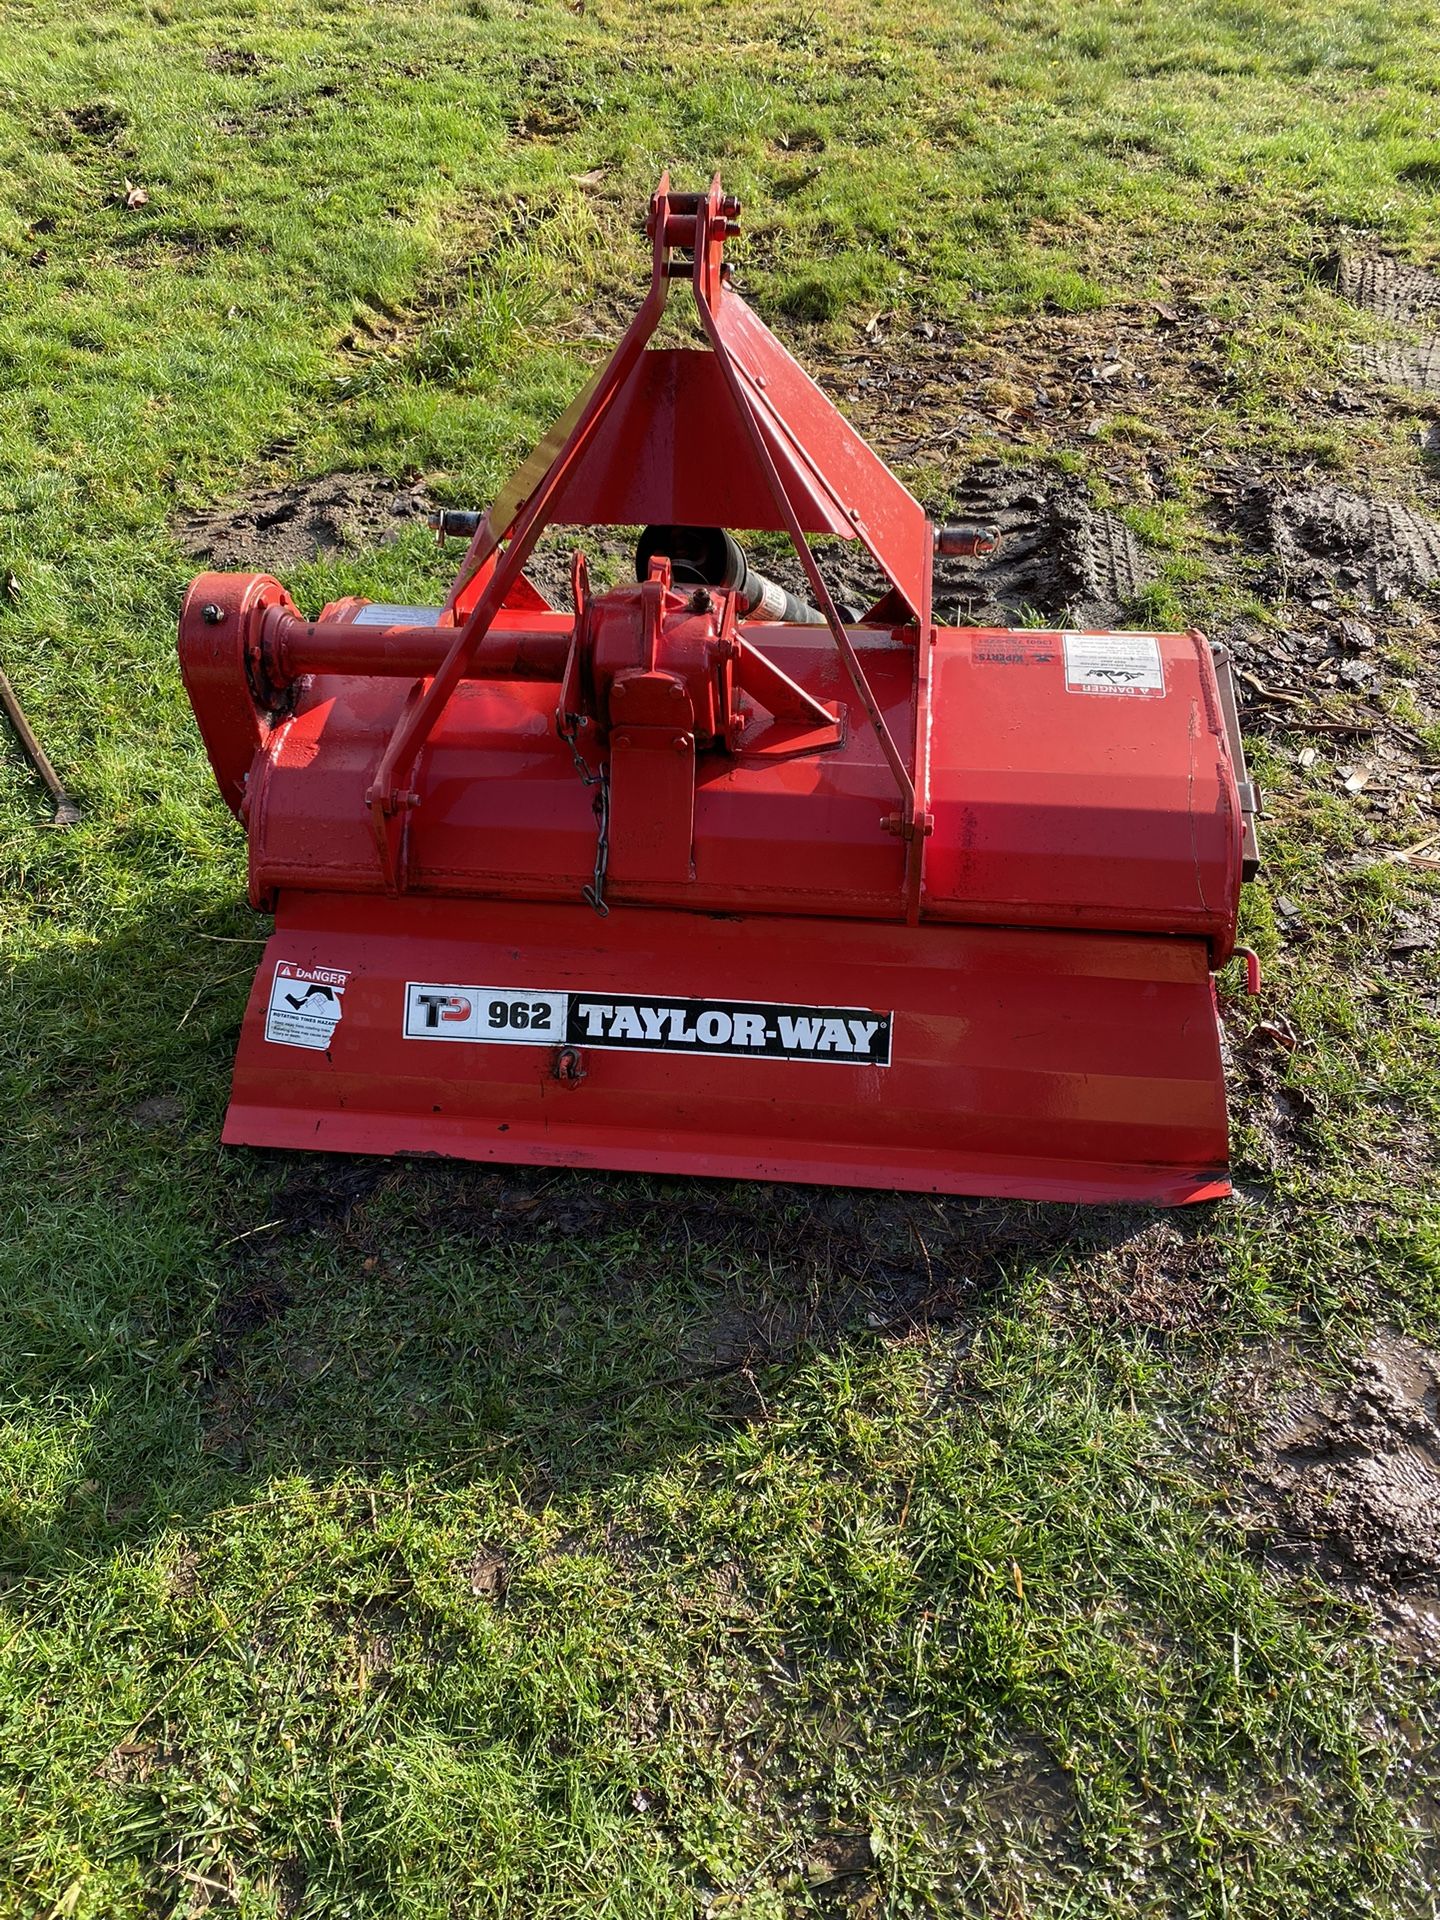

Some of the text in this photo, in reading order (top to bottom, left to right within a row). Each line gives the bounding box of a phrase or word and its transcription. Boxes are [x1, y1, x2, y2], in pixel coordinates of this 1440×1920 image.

[1082, 684, 1135, 694] DANGER
[296, 968, 346, 985] DANGER
[273, 1012, 300, 1020] ROTATING
[488, 1001, 552, 1030] 962
[579, 1005, 879, 1053] TAYLOR-WAY
